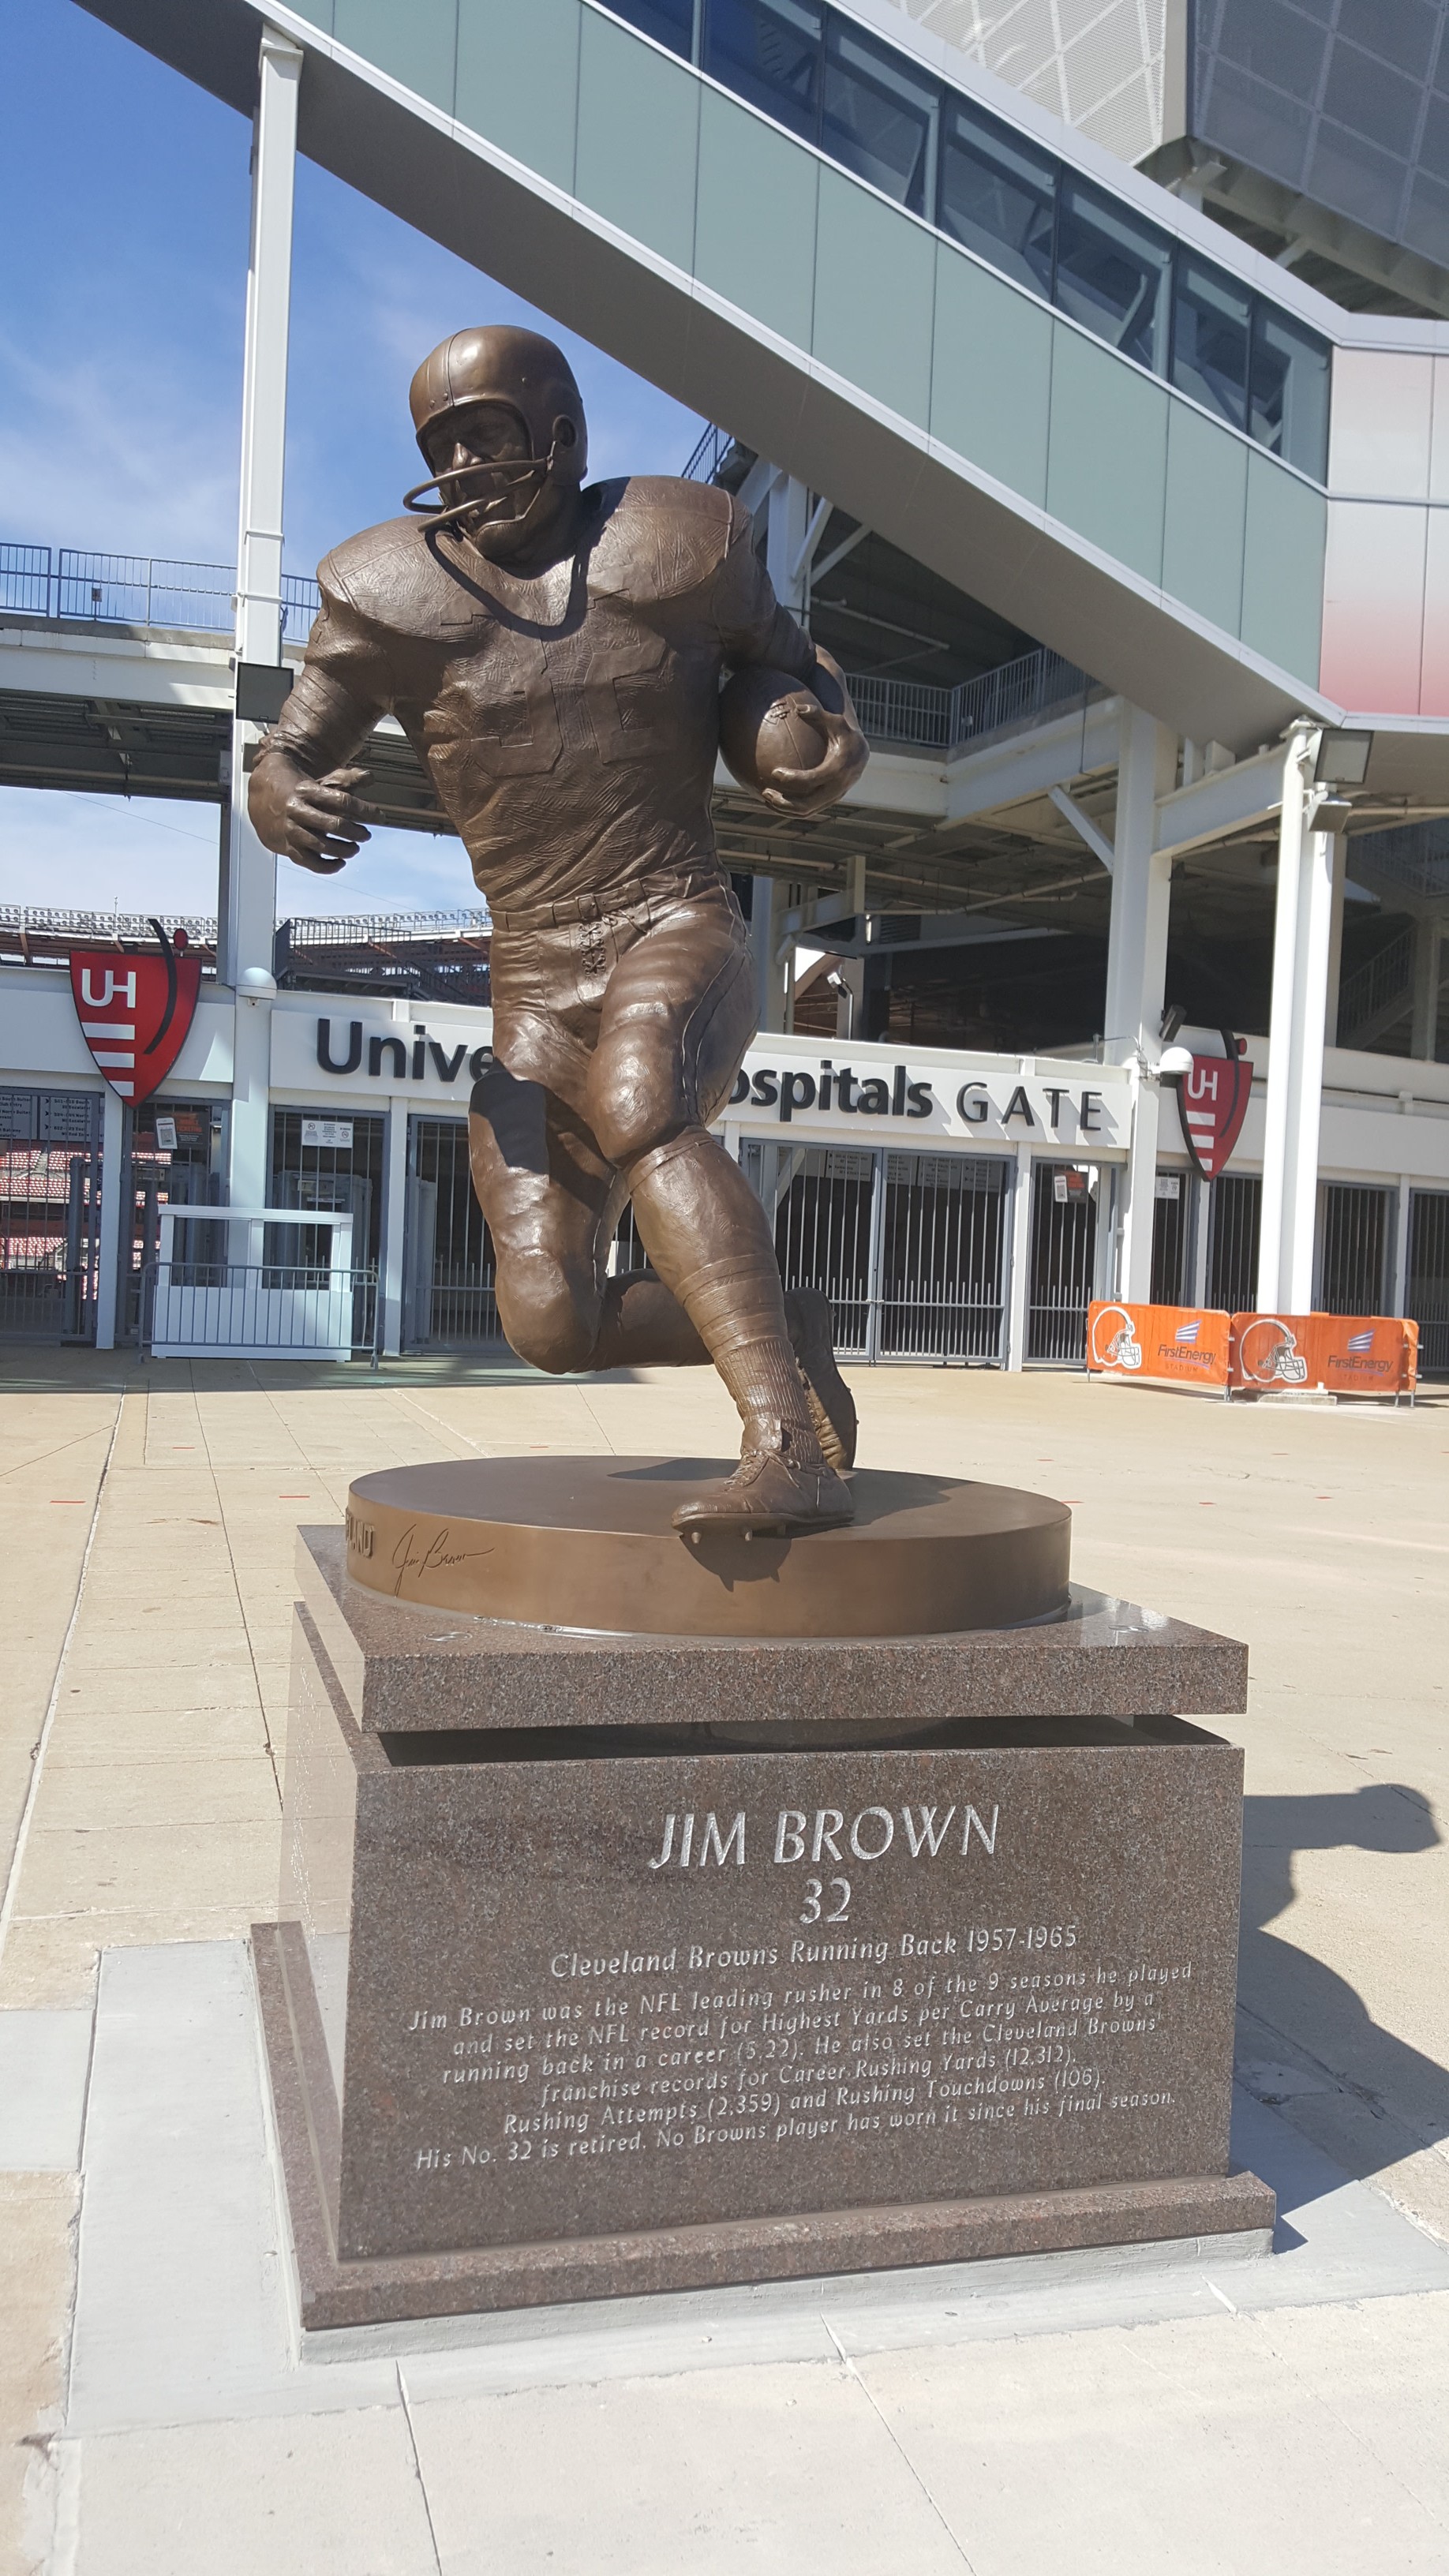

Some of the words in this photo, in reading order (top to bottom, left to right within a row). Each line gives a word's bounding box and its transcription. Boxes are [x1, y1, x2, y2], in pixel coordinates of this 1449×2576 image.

[82, 968, 137, 1008] UH
[317, 1018, 497, 1085] Unive
[727, 1060, 933, 1122] ospitals
[957, 1082, 1103, 1131] GATE
[1188, 1069, 1219, 1102] UH
[1158, 1344, 1216, 1365] FirstEnergy
[1327, 1355, 1394, 1372] FirstEnergy
[648, 1812, 746, 1869] JIM
[773, 1804, 999, 1863] BROWN
[799, 1878, 851, 1924] 32
[551, 1947, 676, 1978] Cleveland
[688, 1945, 778, 1969] Browns
[790, 1938, 889, 1964] Running
[900, 1931, 957, 1956] Back
[967, 1925, 1076, 1953] 1957-1965
[408, 2011, 447, 2031] Jim
[459, 2007, 530, 2027] Brown
[541, 2004, 582, 2020] was
[595, 1997, 628, 2016] the
[640, 1993, 681, 2014] NFL
[692, 1988, 773, 2010] leading
[784, 1983, 852, 2004] rusher
[863, 1981, 882, 1998] in
[893, 1978, 903, 1997] 8
[914, 1975, 936, 1999] of
[946, 1974, 977, 1994] the
[988, 1972, 998, 1990] 9
[1010, 1972, 1086, 1989] seasons
[1097, 1966, 1117, 1984] he
[1129, 1961, 1192, 1987] played
[453, 2034, 492, 2055] and
[504, 2033, 534, 2051] set
[545, 2028, 578, 2047] the
[589, 2023, 629, 2044] NFL
[640, 2018, 710, 2041] record
[720, 2016, 752, 2039] for
[762, 2010, 841, 2035] Highest
[852, 2005, 908, 2026] Yards
[919, 2007, 949, 2027] per
[960, 1999, 1015, 2020] Carry
[1026, 1994, 1103, 2015] Average
[1114, 1990, 1134, 2012] by
[1144, 1993, 1154, 2006] a
[443, 2061, 530, 2084] running
[542, 2054, 593, 2076] back
[604, 2053, 624, 2070] in
[635, 2054, 646, 2069] a
[657, 2048, 726, 2067] career
[815, 2035, 841, 2054] He
[852, 2033, 893, 2052] also
[904, 2031, 930, 2047] set
[942, 2026, 972, 2045] the
[983, 2018, 1078, 2042] Cleveland
[504, 2110, 590, 2133] Rushing
[601, 2100, 698, 2125] Attempts
[790, 2088, 826, 2110] and
[837, 2083, 915, 2105] Rushing
[927, 2074, 1045, 2098] Touchdowns
[541, 2079, 641, 2108] franchise
[650, 2070, 728, 2094] records
[738, 2067, 769, 2091] for
[779, 2064, 846, 2084] Career
[856, 2057, 932, 2078] Rushing
[943, 2052, 996, 2072] Yards
[416, 2148, 451, 2170] His
[462, 2146, 497, 2166] No.
[507, 2140, 532, 2161] 32
[541, 2138, 560, 2158] is
[569, 2131, 646, 2155] retired.
[657, 2130, 684, 2147] No
[694, 2125, 766, 2144] Browns
[777, 2118, 838, 2142] player
[848, 2113, 880, 2130] has
[889, 2110, 937, 2127] worn
[945, 2105, 957, 2122] it
[968, 2102, 1015, 2120] since
[1024, 2097, 1050, 2115] his
[1058, 2092, 1102, 2117] final
[1110, 2092, 1176, 2109] season.
